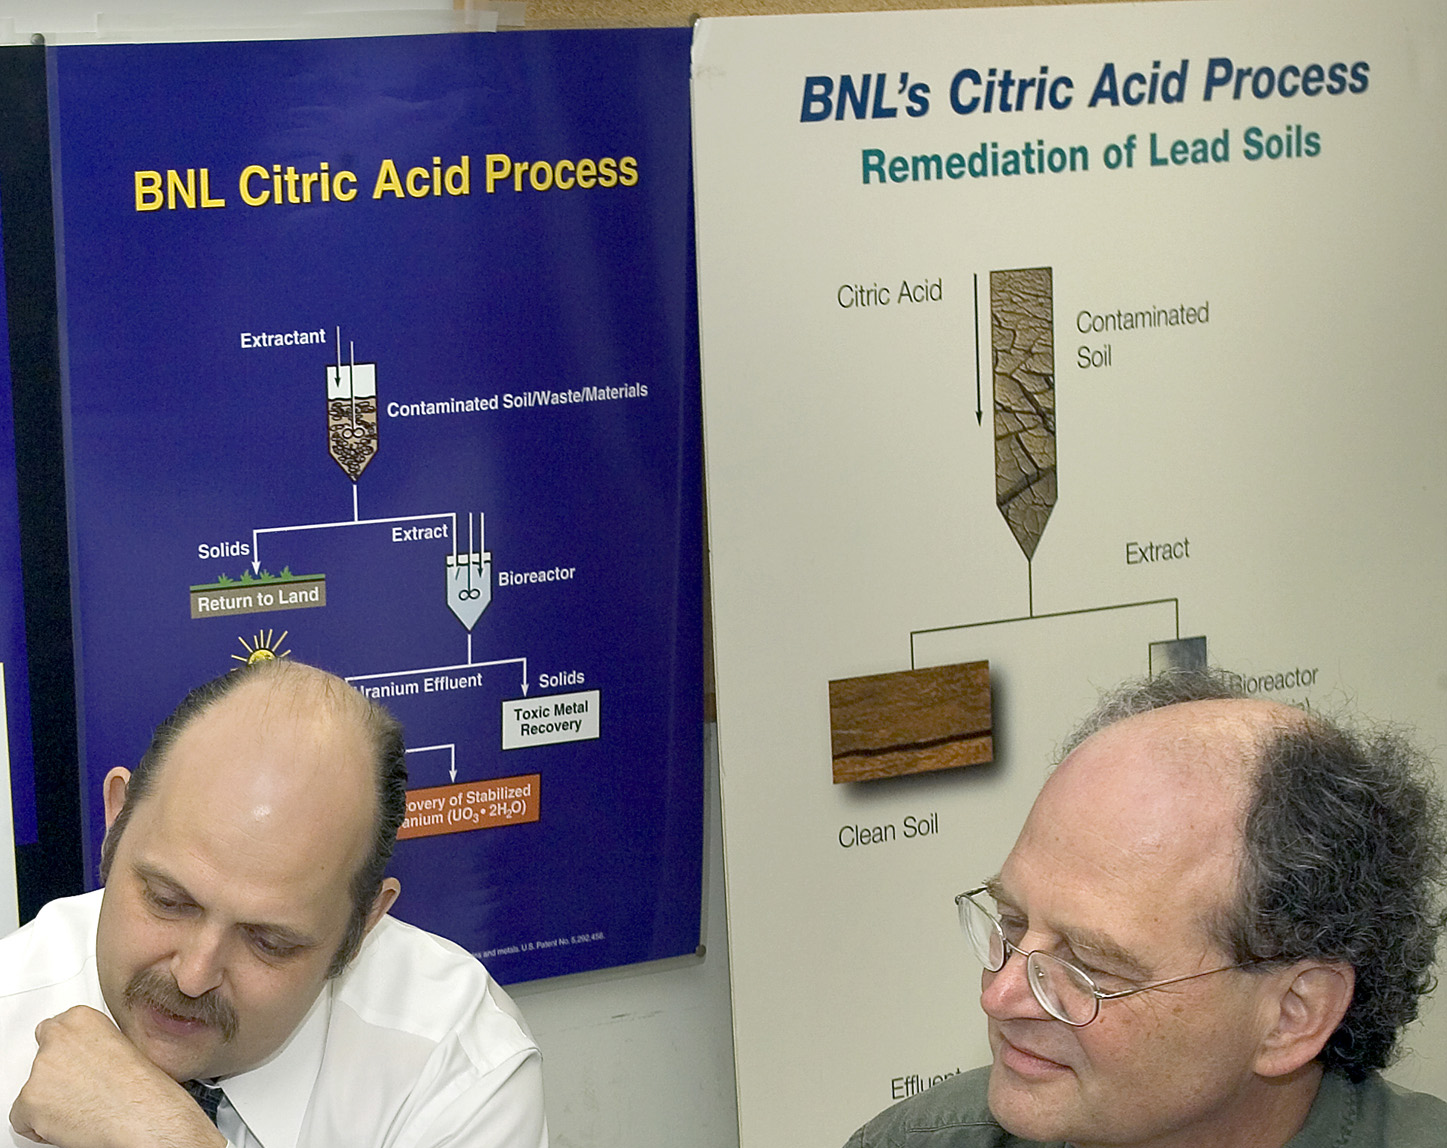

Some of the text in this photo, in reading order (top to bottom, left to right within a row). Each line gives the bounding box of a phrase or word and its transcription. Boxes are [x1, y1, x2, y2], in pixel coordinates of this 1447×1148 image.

[950, 66, 1073, 115] Citric
[1088, 59, 1189, 107] Acid
[1204, 58, 1370, 101] Process
[862, 125, 1321, 184] Remediation of Lead Soils
[135, 154, 638, 211] BNL Citric Acid Process
[838, 278, 942, 308] Citric Acid
[1077, 301, 1209, 333] Contaminated
[241, 329, 326, 348] Extractant
[1078, 345, 1111, 368] Soil
[387, 383, 648, 417] Contaminated Soil/Waste/Materials
[392, 524, 448, 542] Extract
[199, 541, 249, 559] Solids
[1126, 538, 1189, 564] Extract
[499, 567, 575, 586] Bioreactor
[198, 587, 318, 612] Return to Land
[424, 673, 482, 692] Effluent
[539, 671, 584, 688] Solids
[514, 700, 588, 720] Toxic Metal
[521, 720, 581, 736] Recovery
[450, 784, 530, 806] of Stabilized
[839, 813, 938, 848] Clean Soil
